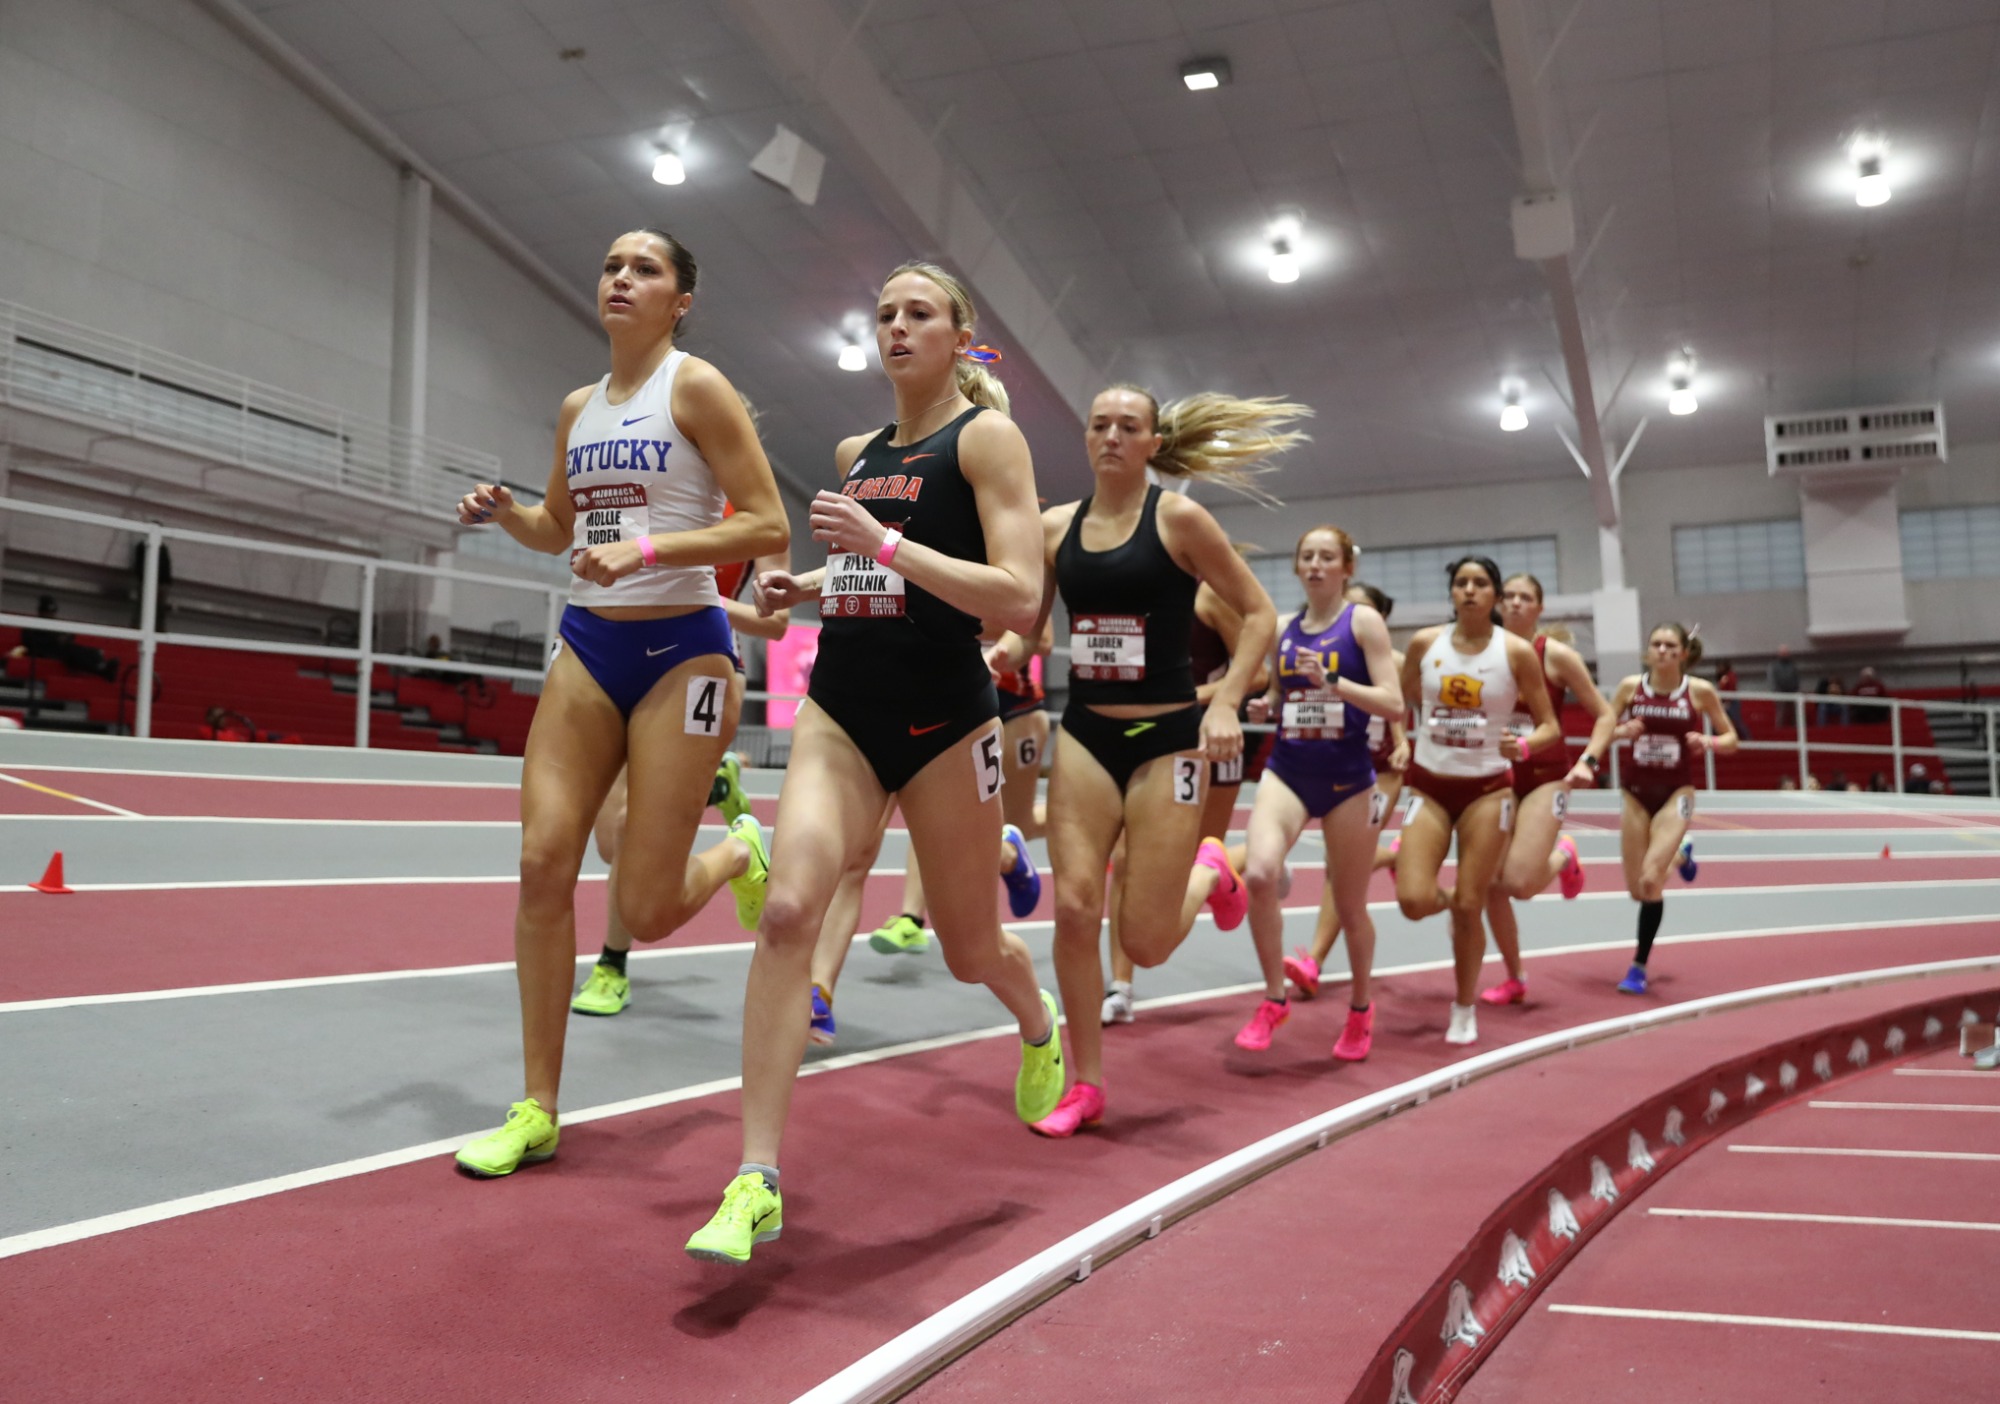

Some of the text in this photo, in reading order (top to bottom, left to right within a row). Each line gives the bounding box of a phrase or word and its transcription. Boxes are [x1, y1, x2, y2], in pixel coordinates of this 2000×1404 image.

[841, 475, 923, 502] FLORIDA
[586, 510, 621, 527] MOLLIE
[831, 575, 888, 592] PUSTILNIK
[1087, 636, 1123, 649] LAUREN
[1094, 651, 1116, 663] PING
[1279, 651, 1339, 677] LU
[693, 681, 718, 733] 4
[981, 734, 999, 794] 5
[1020, 738, 1036, 765] 6
[1181, 761, 1196, 801] 3
[1556, 792, 1566, 817] 9
